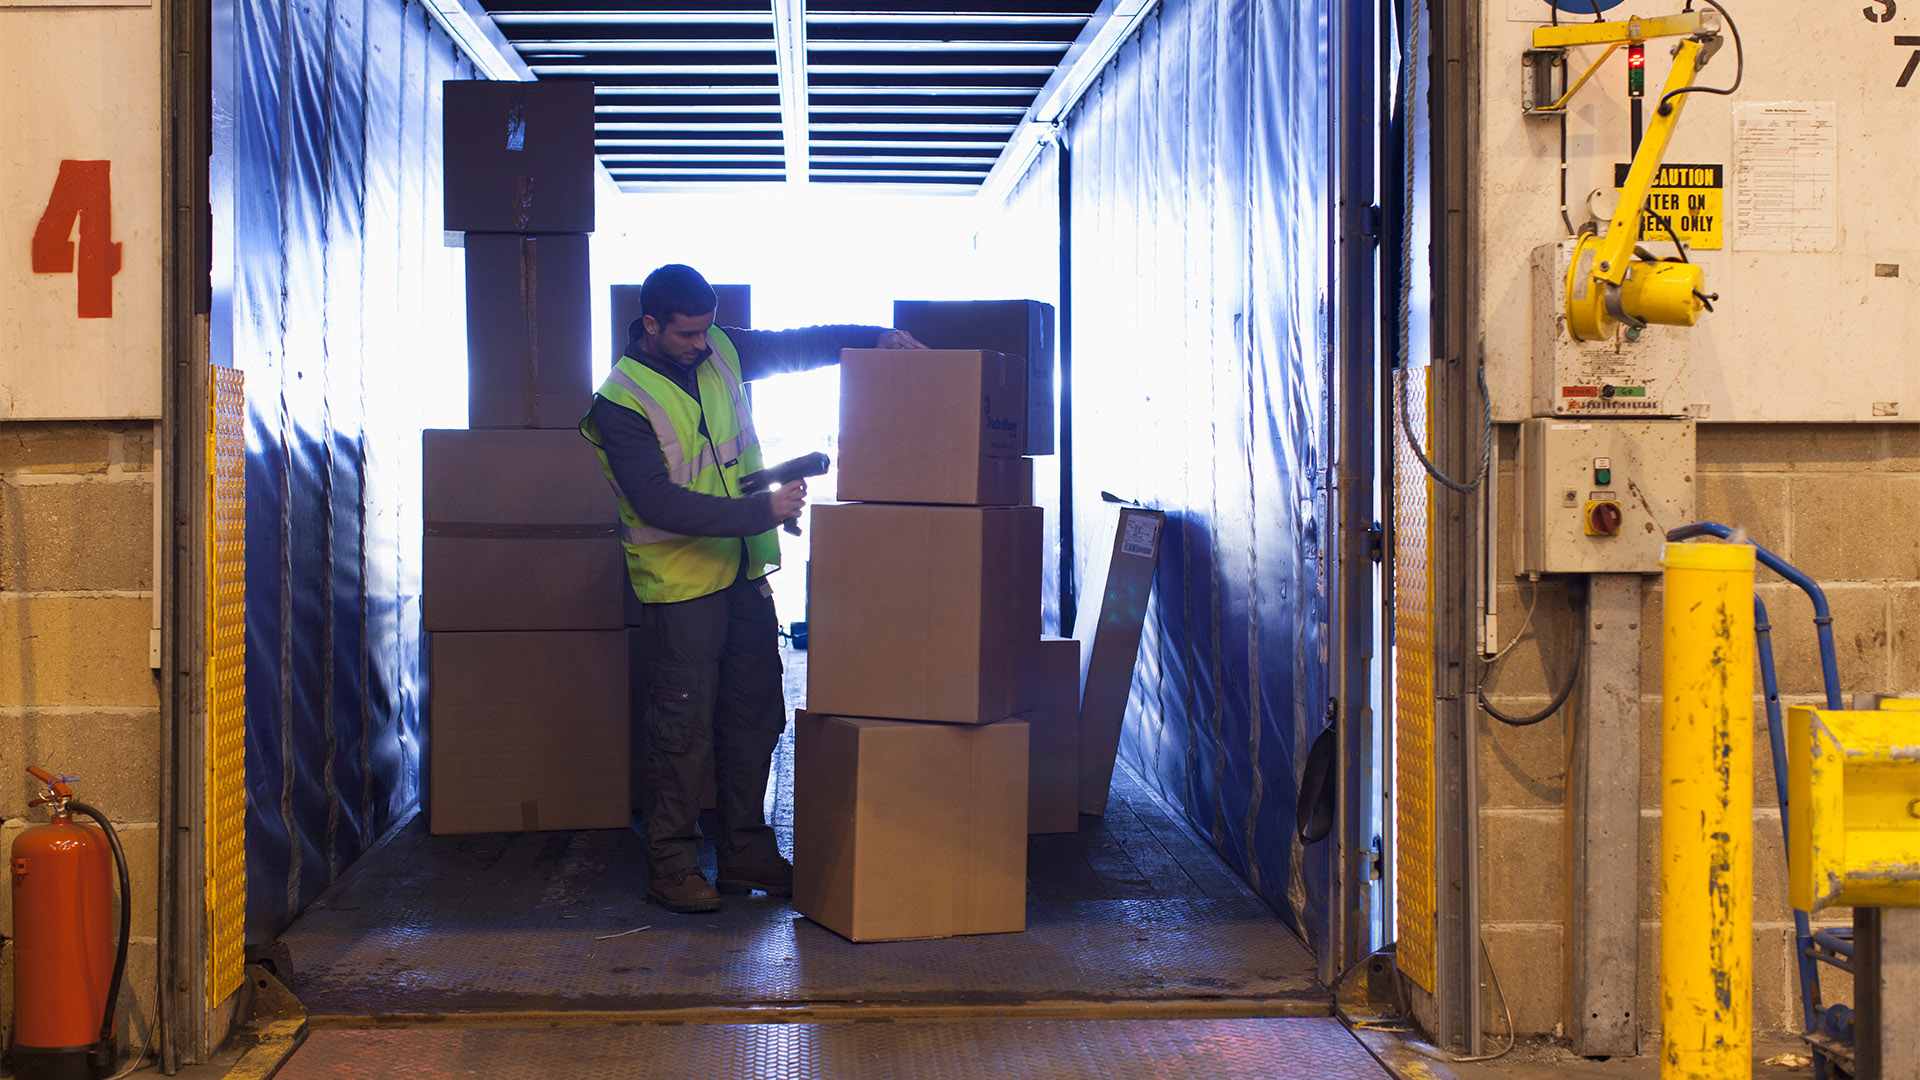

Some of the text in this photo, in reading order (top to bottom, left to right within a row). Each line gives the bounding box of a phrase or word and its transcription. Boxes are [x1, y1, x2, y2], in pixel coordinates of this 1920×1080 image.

[1894, 35, 1920, 87] 7
[1646, 194, 1706, 210] TER ON
[31, 160, 122, 318] 4
[1641, 215, 1714, 232] EEN ONLY
